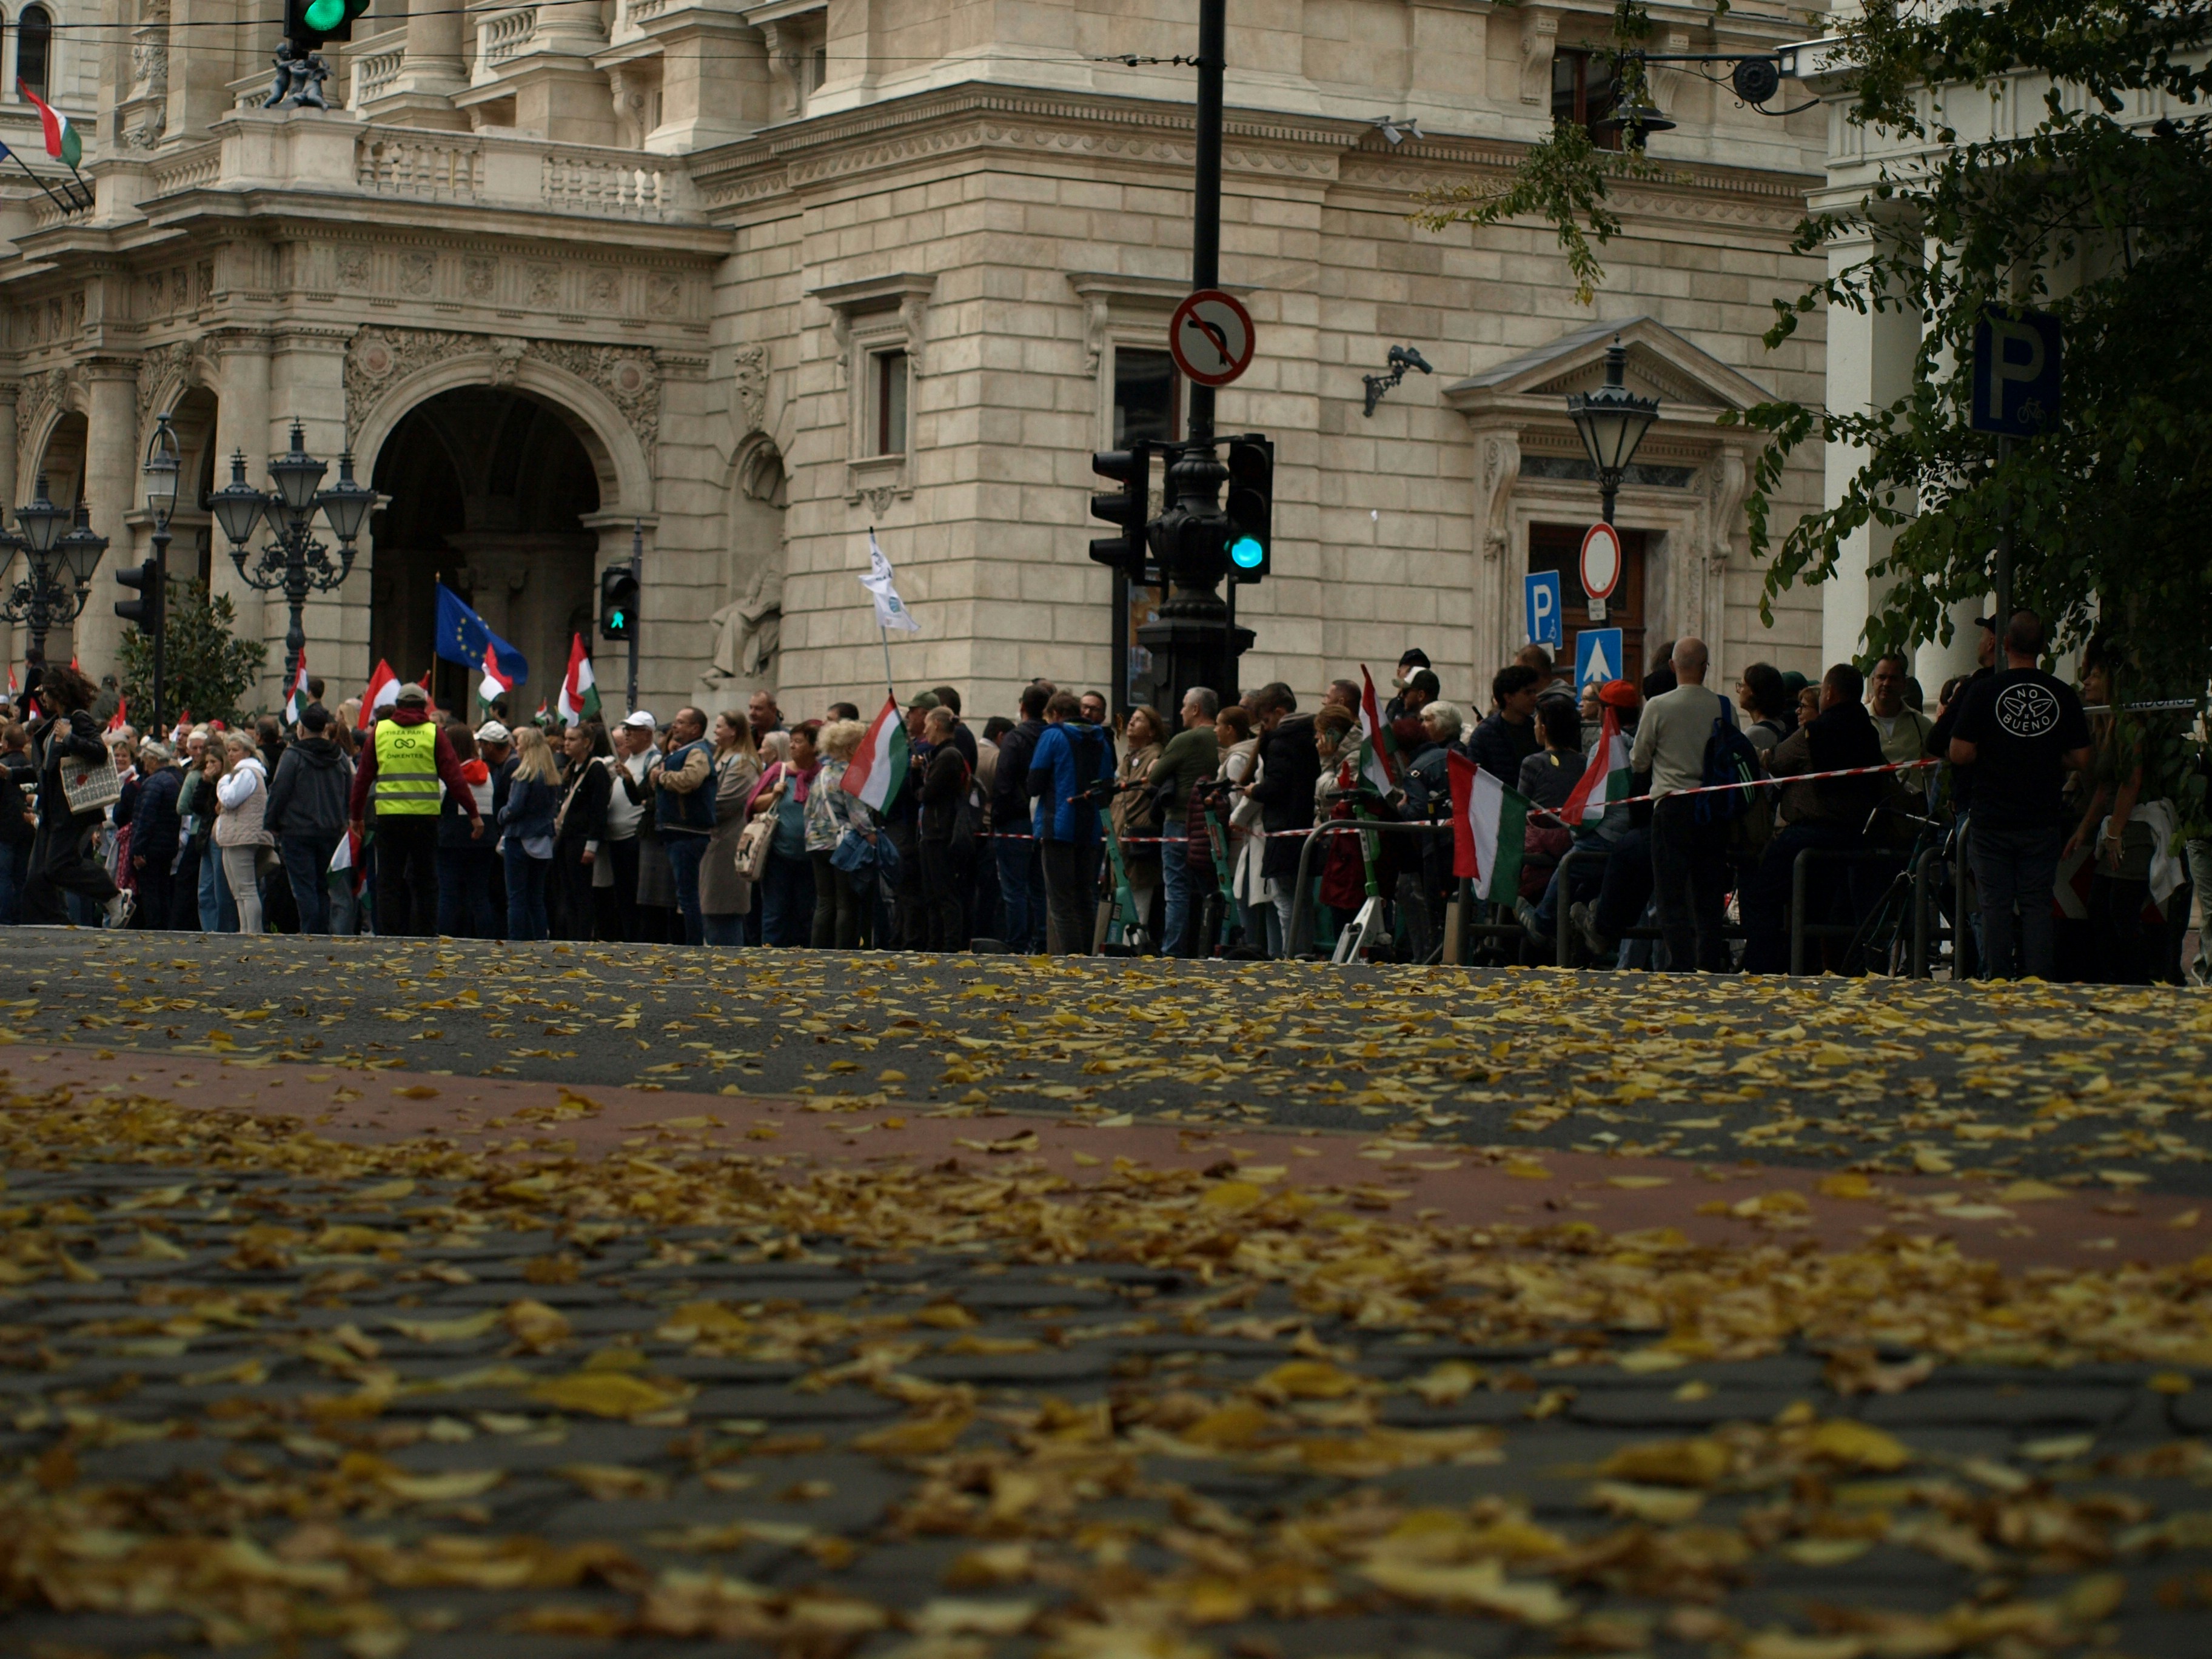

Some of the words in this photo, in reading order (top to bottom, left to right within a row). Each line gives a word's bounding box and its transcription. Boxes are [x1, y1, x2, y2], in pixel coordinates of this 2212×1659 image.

[1989, 318, 2045, 420] P
[1533, 585, 1552, 641] P
[2016, 688, 2038, 699] NO
[2003, 713, 2050, 731] BUENO
